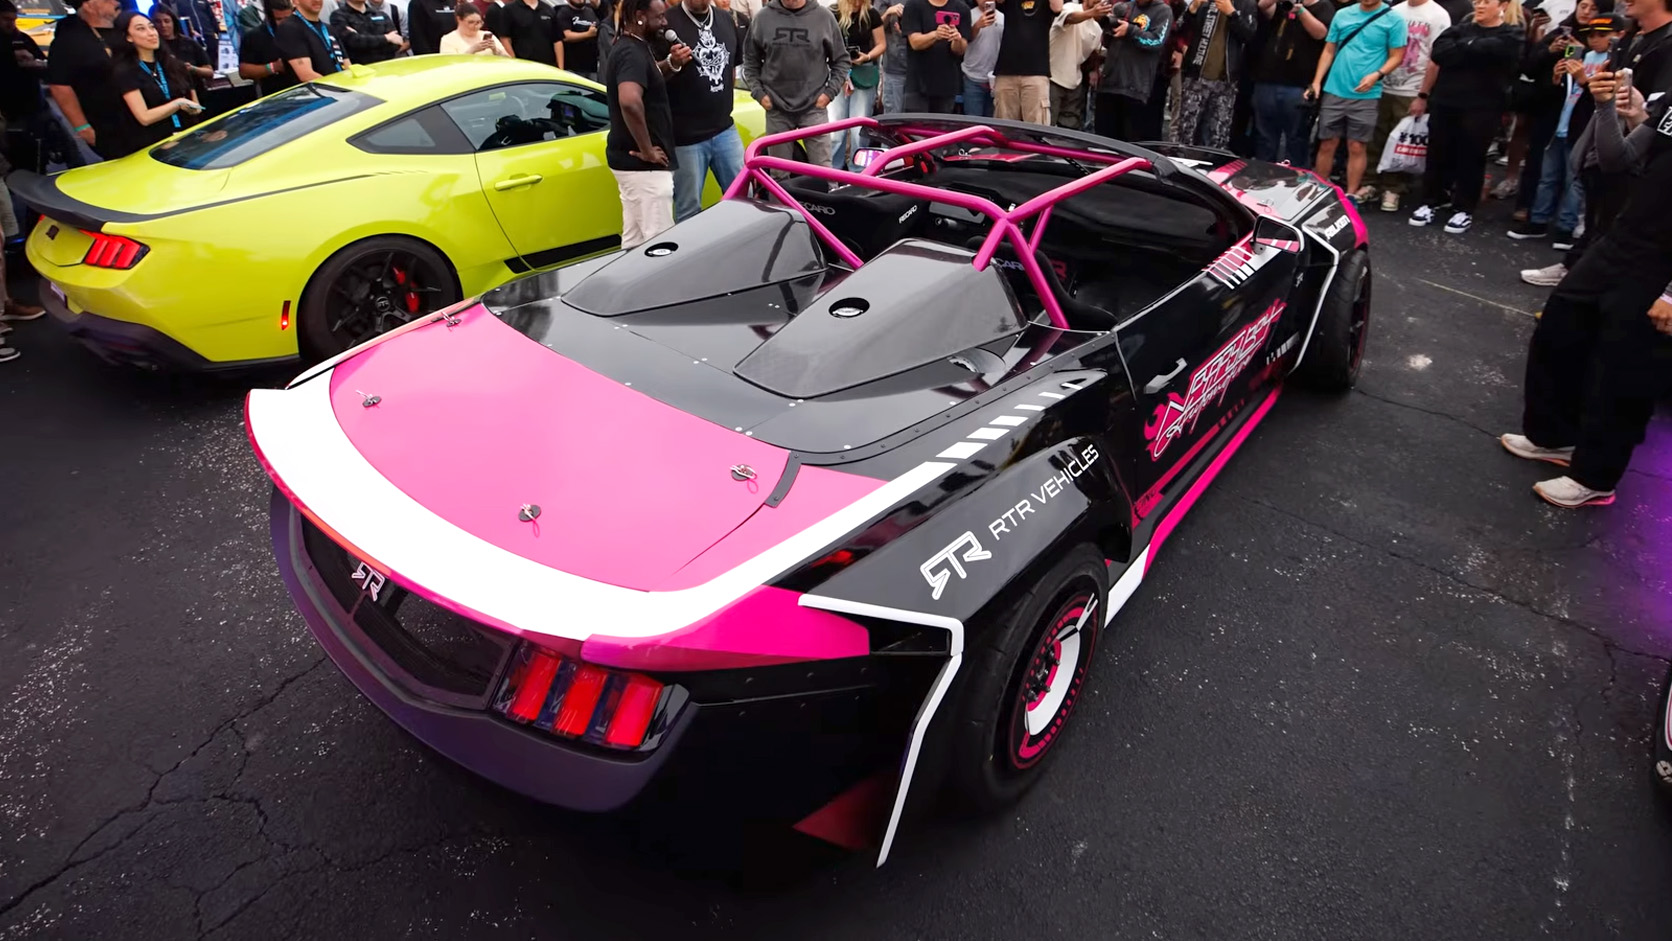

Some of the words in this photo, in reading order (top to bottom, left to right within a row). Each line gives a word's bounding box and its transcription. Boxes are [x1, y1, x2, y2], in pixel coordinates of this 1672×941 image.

[799, 201, 836, 216] CARO
[988, 499, 1035, 541] RTR
[1031, 444, 1099, 504] VEHICLES
